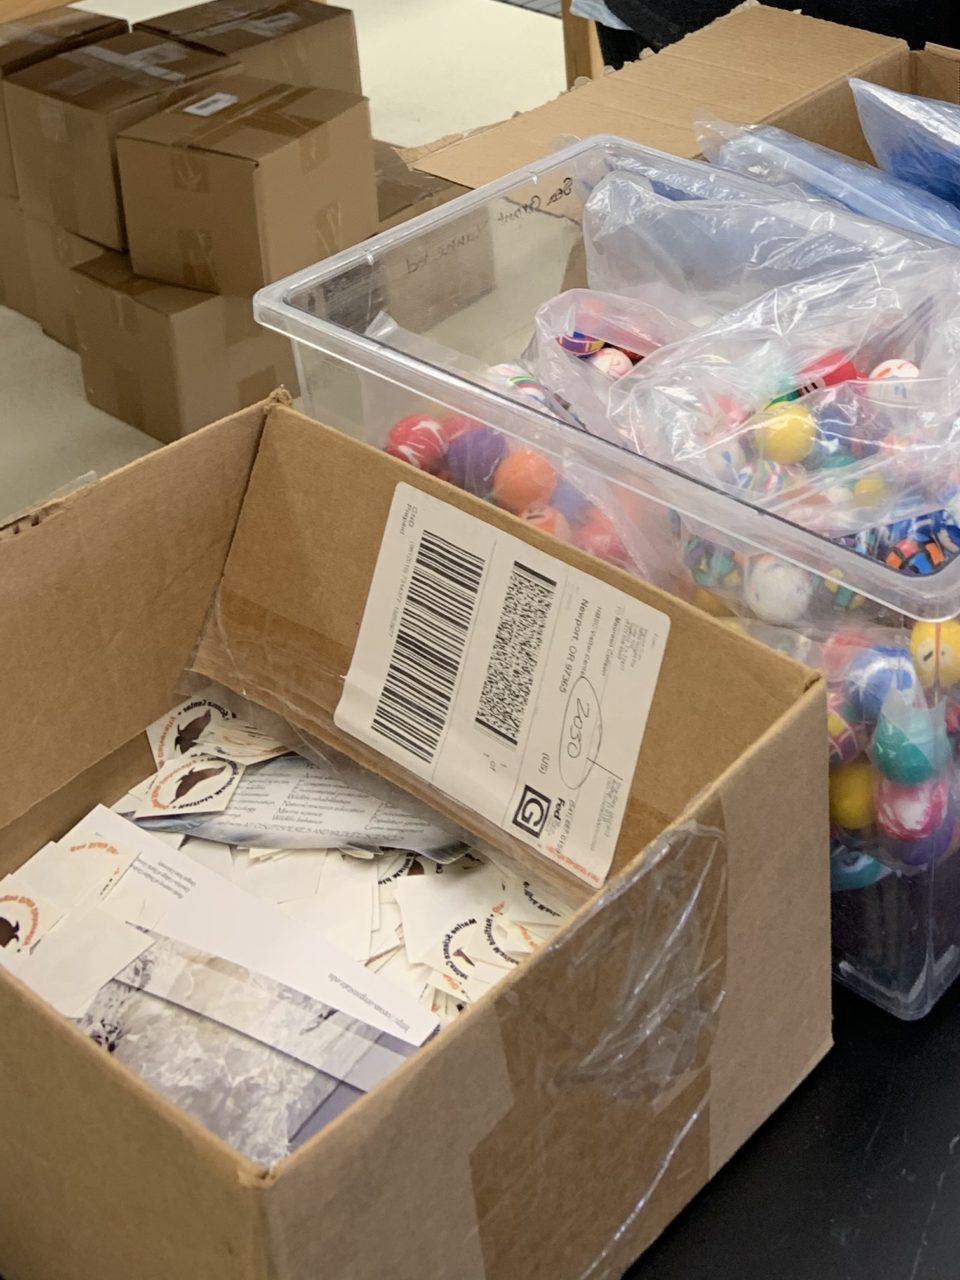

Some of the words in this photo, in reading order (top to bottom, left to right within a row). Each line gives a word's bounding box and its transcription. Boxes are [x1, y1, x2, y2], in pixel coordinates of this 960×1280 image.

[570, 599, 589, 641] Newport,
[567, 645, 578, 662] OR
[559, 663, 573, 694] 97365
[537, 752, 551, 775] (US)
[521, 797, 545, 827] G
